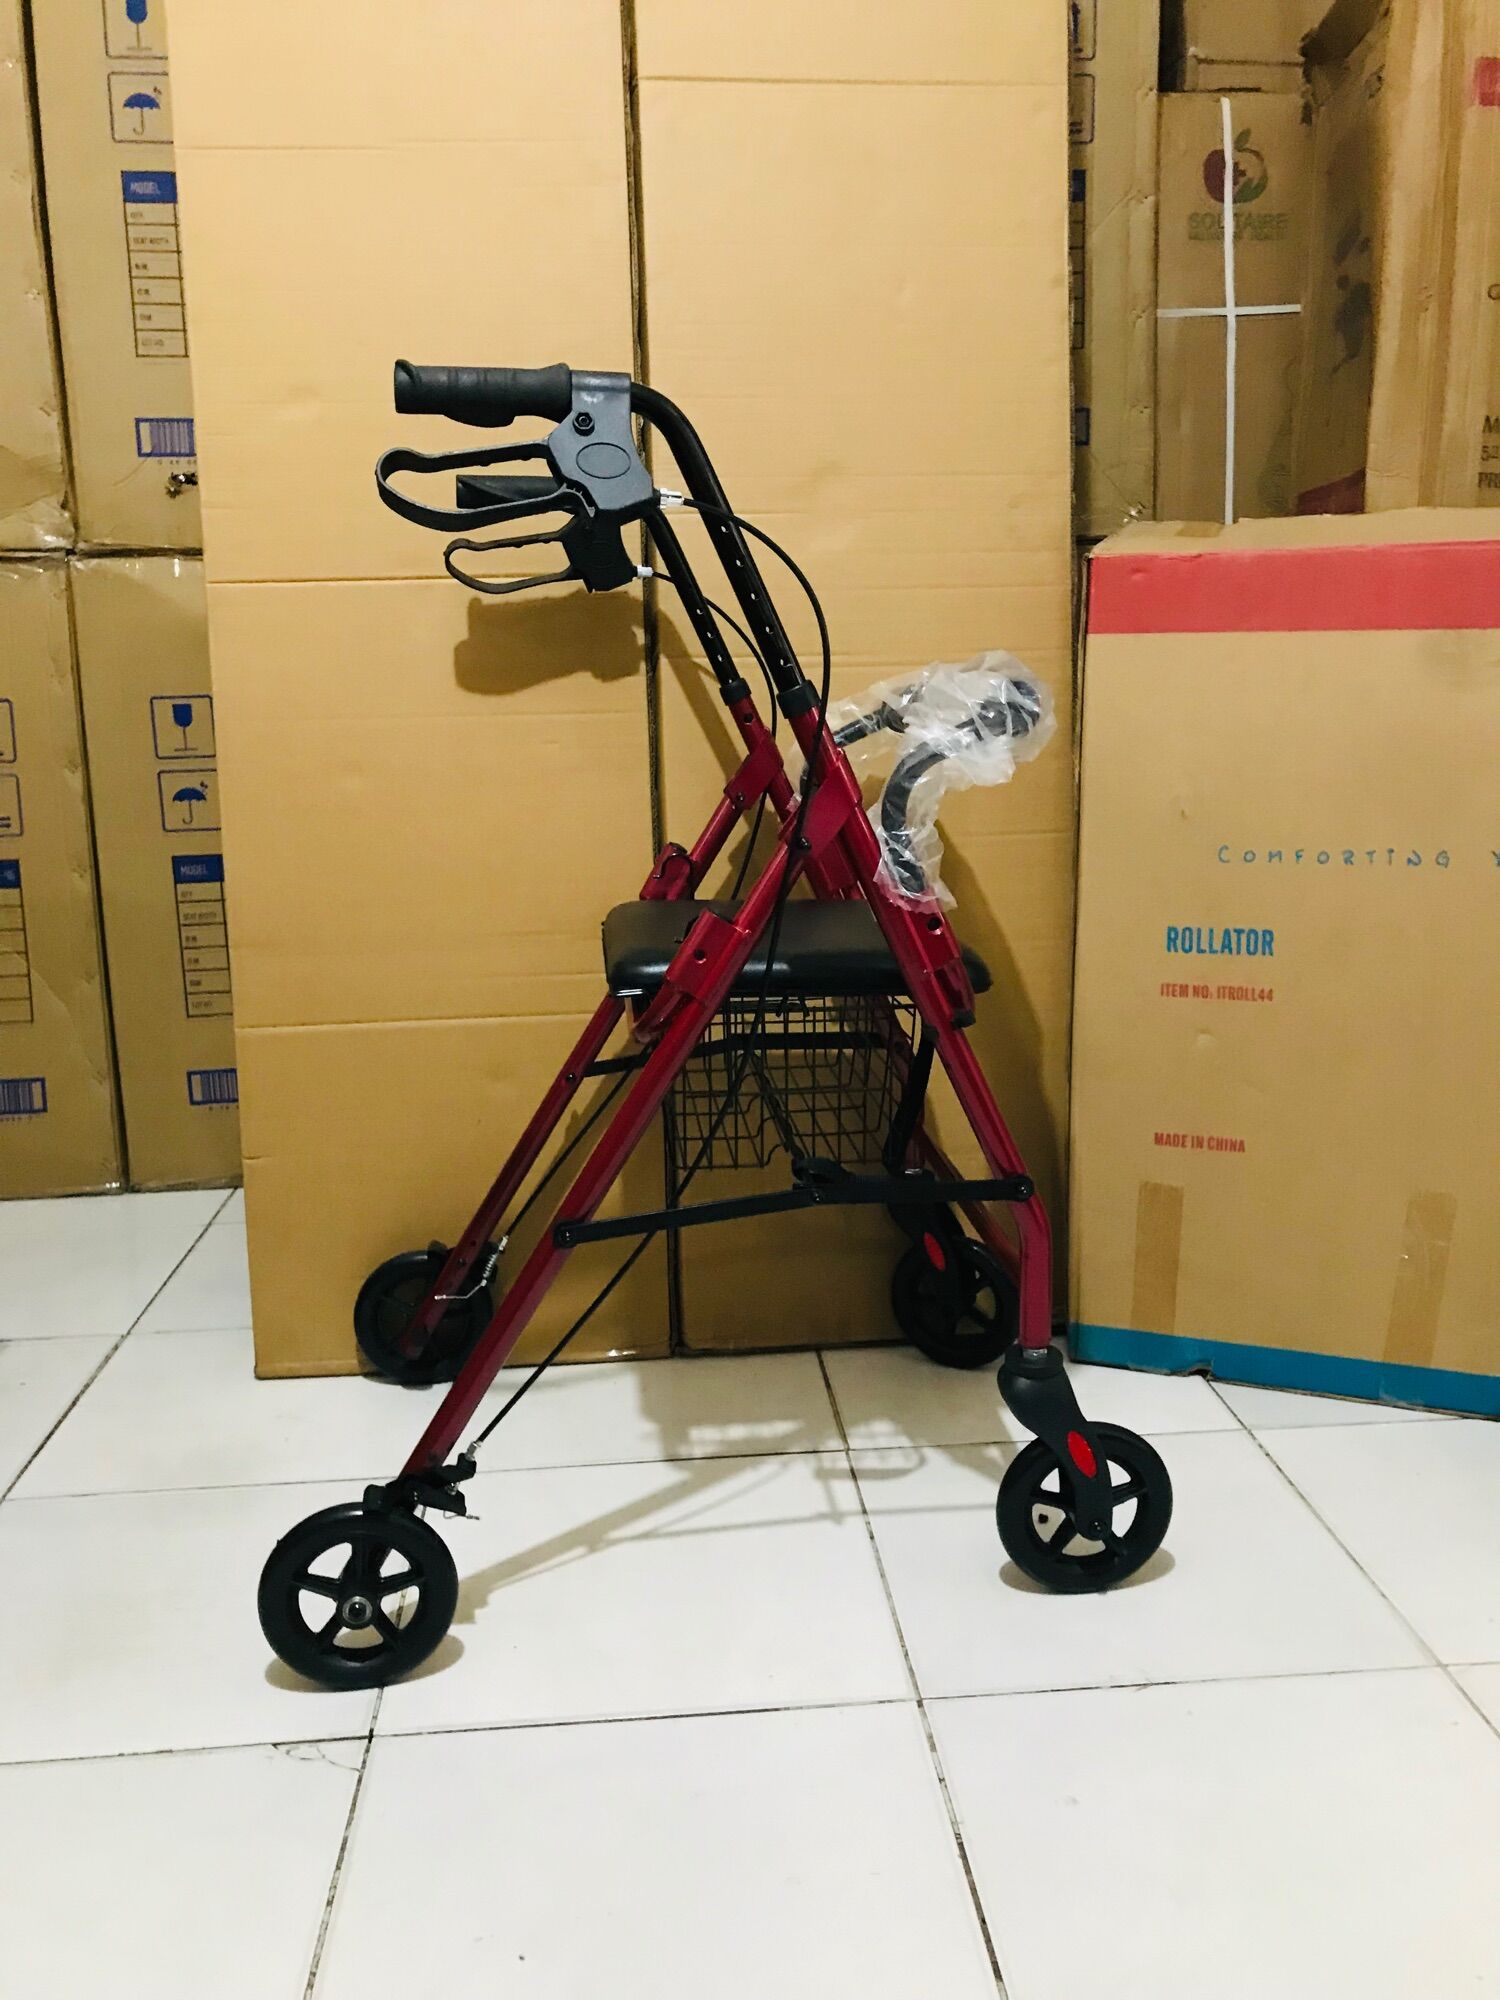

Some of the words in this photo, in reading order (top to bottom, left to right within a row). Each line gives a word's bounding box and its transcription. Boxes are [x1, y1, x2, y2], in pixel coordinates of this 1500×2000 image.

[1188, 212, 1289, 229] SOLTAIRE
[1217, 845, 1450, 868] COMFORTING
[1166, 926, 1274, 957] ROLLATOR
[1160, 983, 1189, 998] ITEM
[1217, 986, 1274, 1001] ITROLL44
[1154, 1132, 1187, 1148] MADE
[1191, 1135, 1204, 1149] IN
[1207, 1137, 1245, 1153] CHINA
